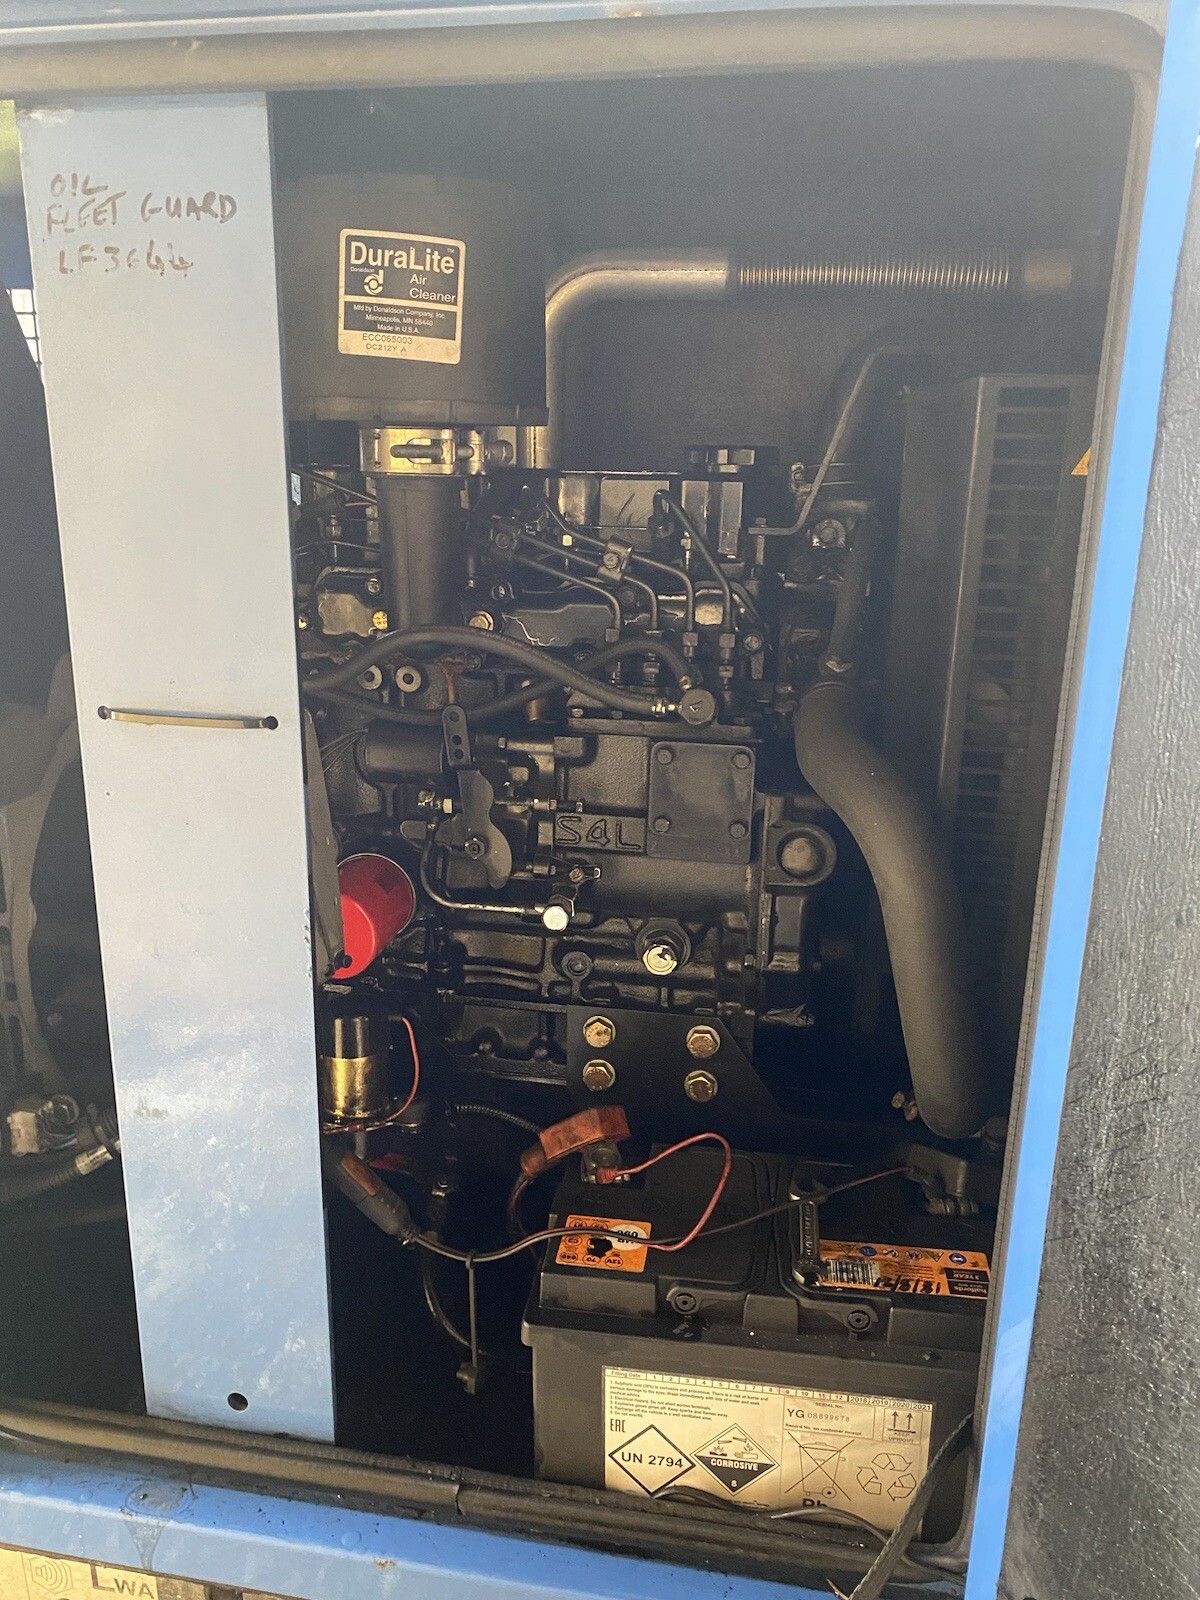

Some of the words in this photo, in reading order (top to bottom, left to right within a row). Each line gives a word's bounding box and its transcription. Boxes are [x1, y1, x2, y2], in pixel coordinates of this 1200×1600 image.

[50, 172, 109, 197] OIL
[46, 190, 127, 235] FLEET
[140, 190, 238, 224] GUARD
[350, 241, 455, 274] DuraLite
[409, 273, 428, 285] Air
[409, 287, 456, 303] Cleaner
[373, 305, 404, 314] Donaldson
[362, 333, 413, 344] ECC065003
[366, 343, 398, 352] DC212Y
[556, 815, 641, 850] S4L
[787, 1408, 804, 1418] YG
[621, 1451, 643, 1464] UN
[648, 1454, 684, 1468] 2794
[710, 1458, 759, 1472] CORROSIVE
[731, 1480, 738, 1488] 8
